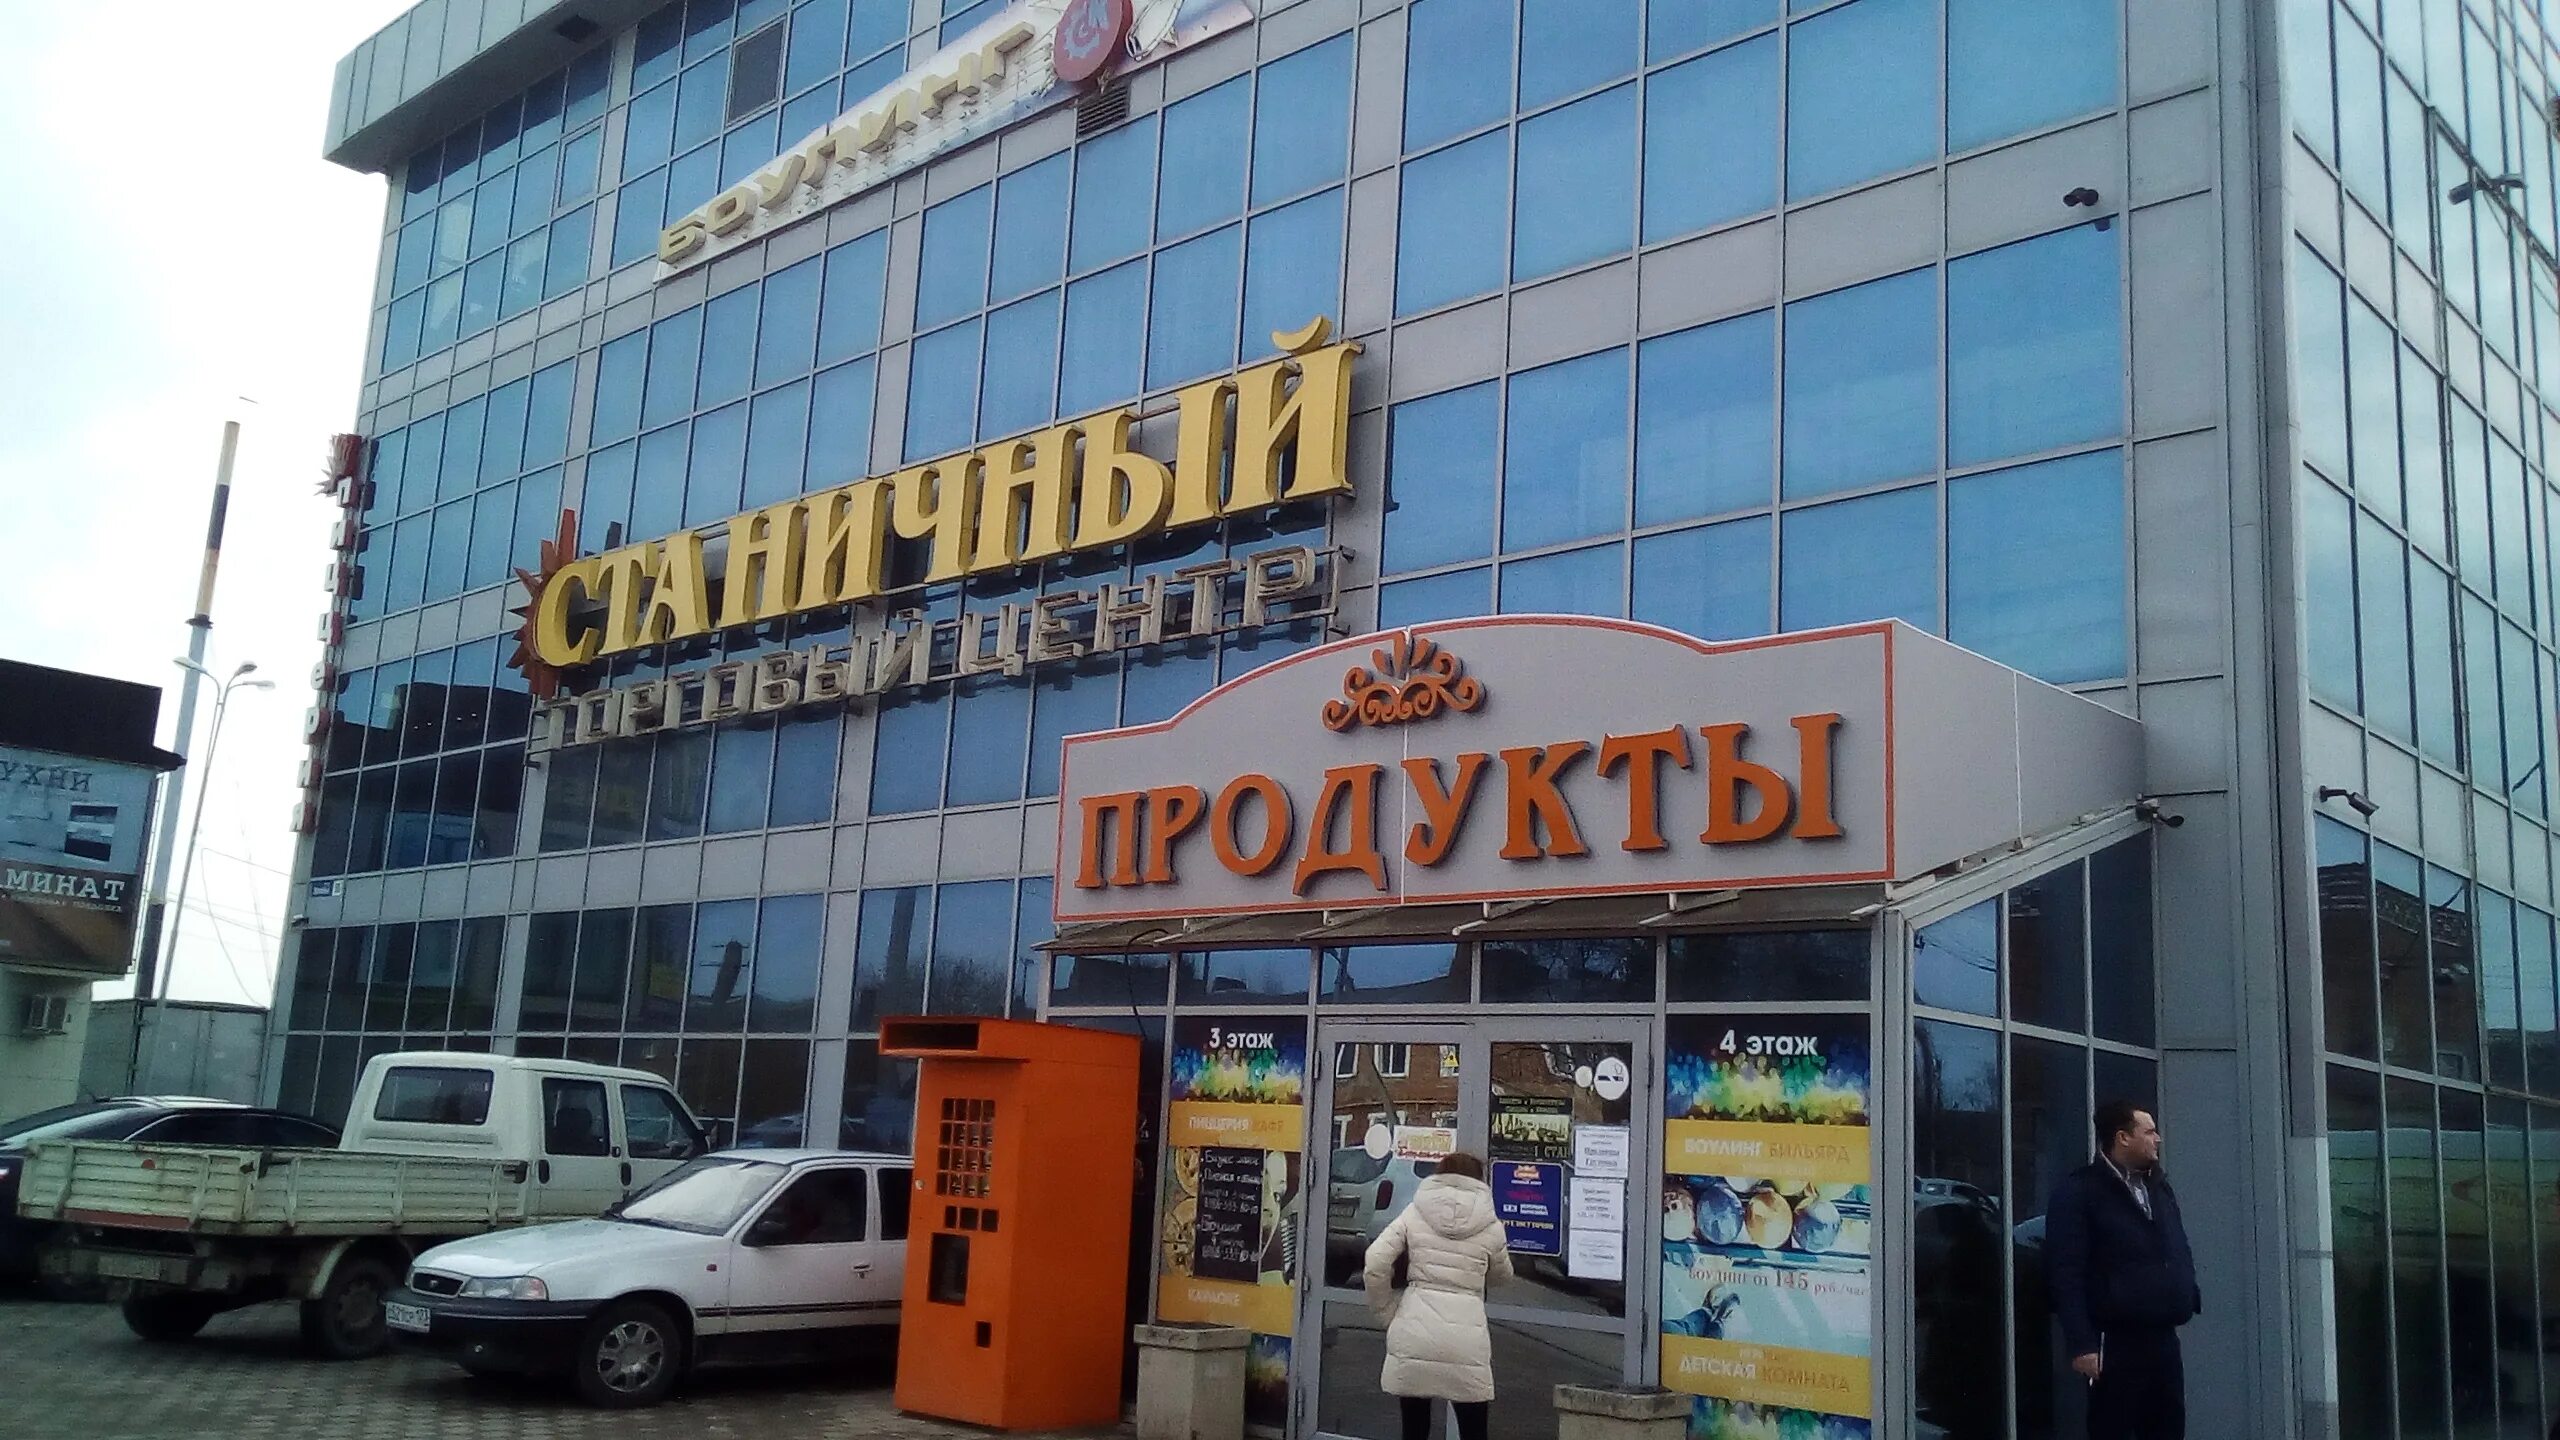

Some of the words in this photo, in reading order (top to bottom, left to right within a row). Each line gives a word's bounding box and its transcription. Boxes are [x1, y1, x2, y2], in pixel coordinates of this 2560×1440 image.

[659, 22, 1036, 265] БОУЛИНГ
[533, 315, 1364, 667] СТАНИЧНЫЙ
[537, 607, 933, 749] ТОРГОВЫЙ
[957, 544, 1317, 677] ЦЕНТР
[1075, 712, 1845, 895] ПРОДУКТЫ
[0, 869, 125, 902] МИНАТ
[1209, 1027, 1221, 1049] 3
[1226, 1032, 1274, 1049] этаж
[1719, 1029, 1736, 1055] 4
[1746, 1034, 1819, 1056] этаж
[1684, 1137, 1763, 1157] БОУЛИНГ
[1768, 1142, 1850, 1164] БИЛЬЯРД
[1776, 1269, 1808, 1290] 145
[1679, 1355, 1757, 1380] ДЕТСКАЯ
[1761, 1366, 1850, 1393] КОМНАТА
